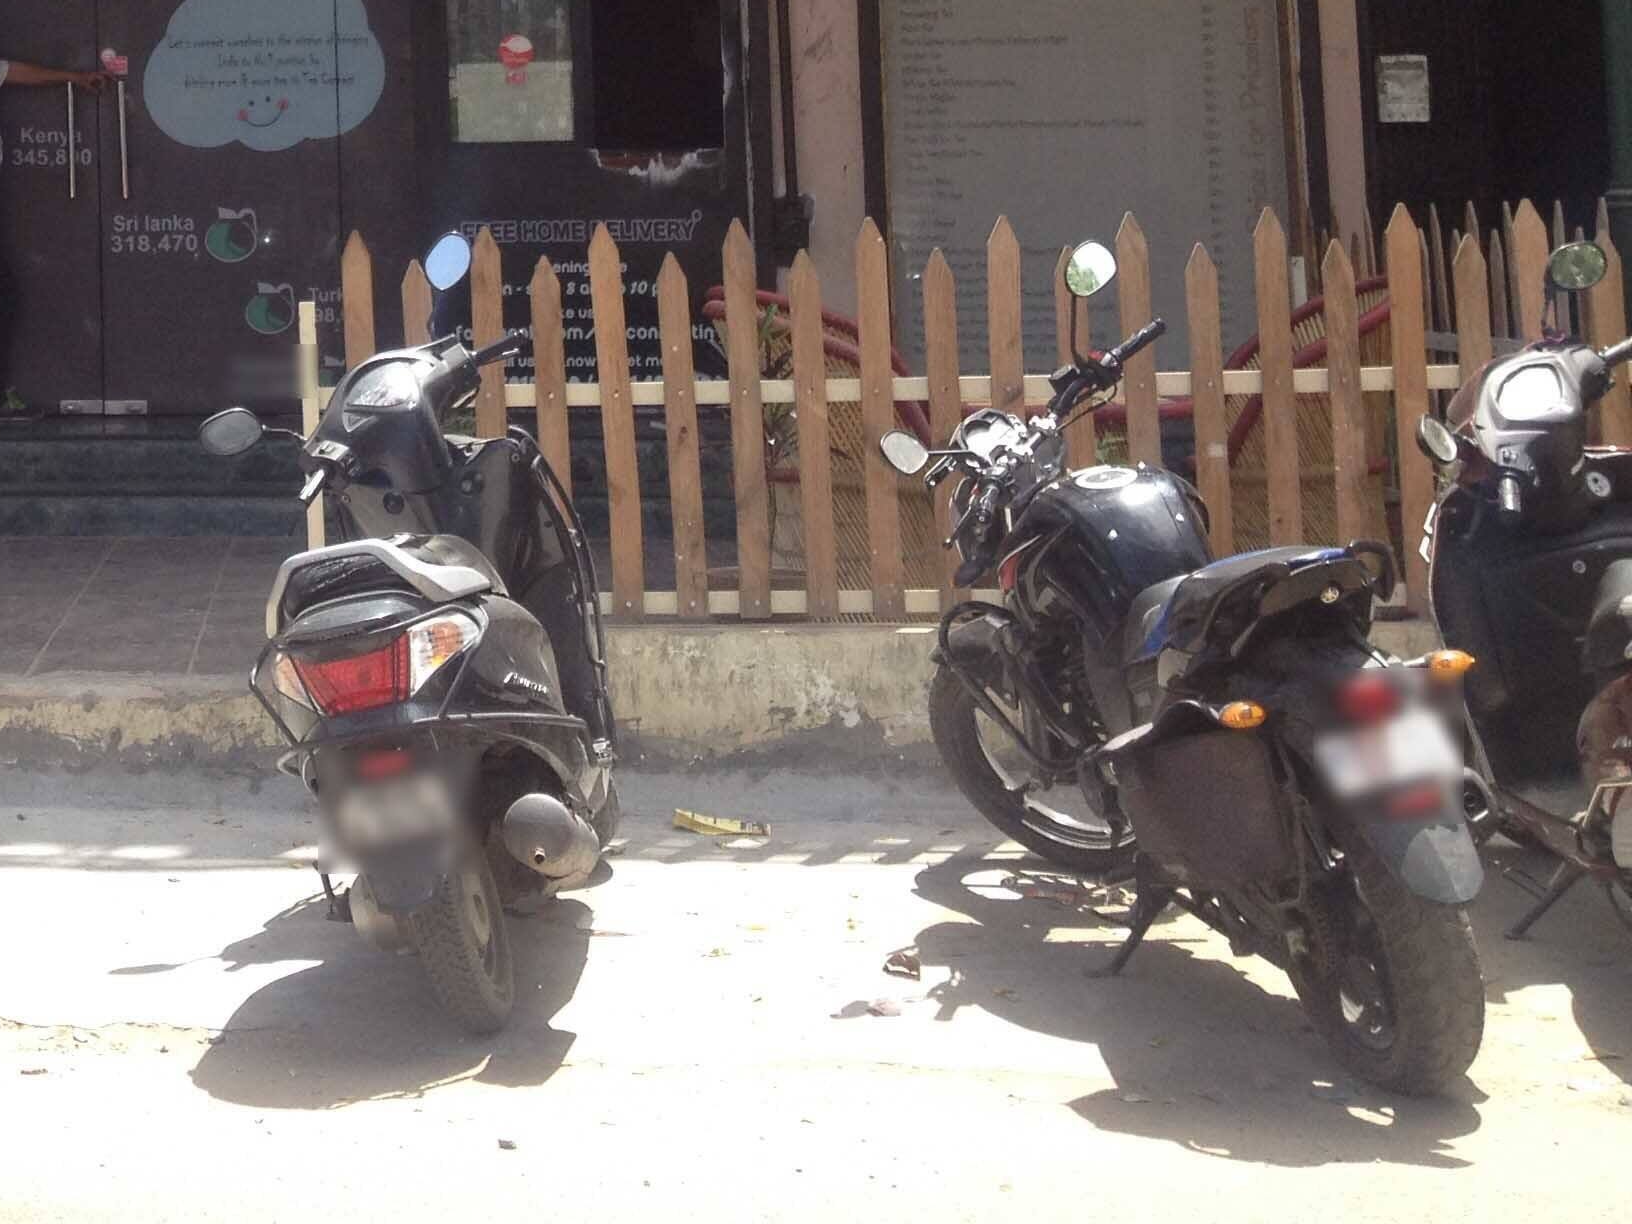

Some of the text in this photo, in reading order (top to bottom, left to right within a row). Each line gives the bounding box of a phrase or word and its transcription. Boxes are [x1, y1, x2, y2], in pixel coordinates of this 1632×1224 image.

[112, 214, 196, 233] Sri lanka
[519, 219, 585, 243] HOME
[110, 234, 199, 255] 318,470
